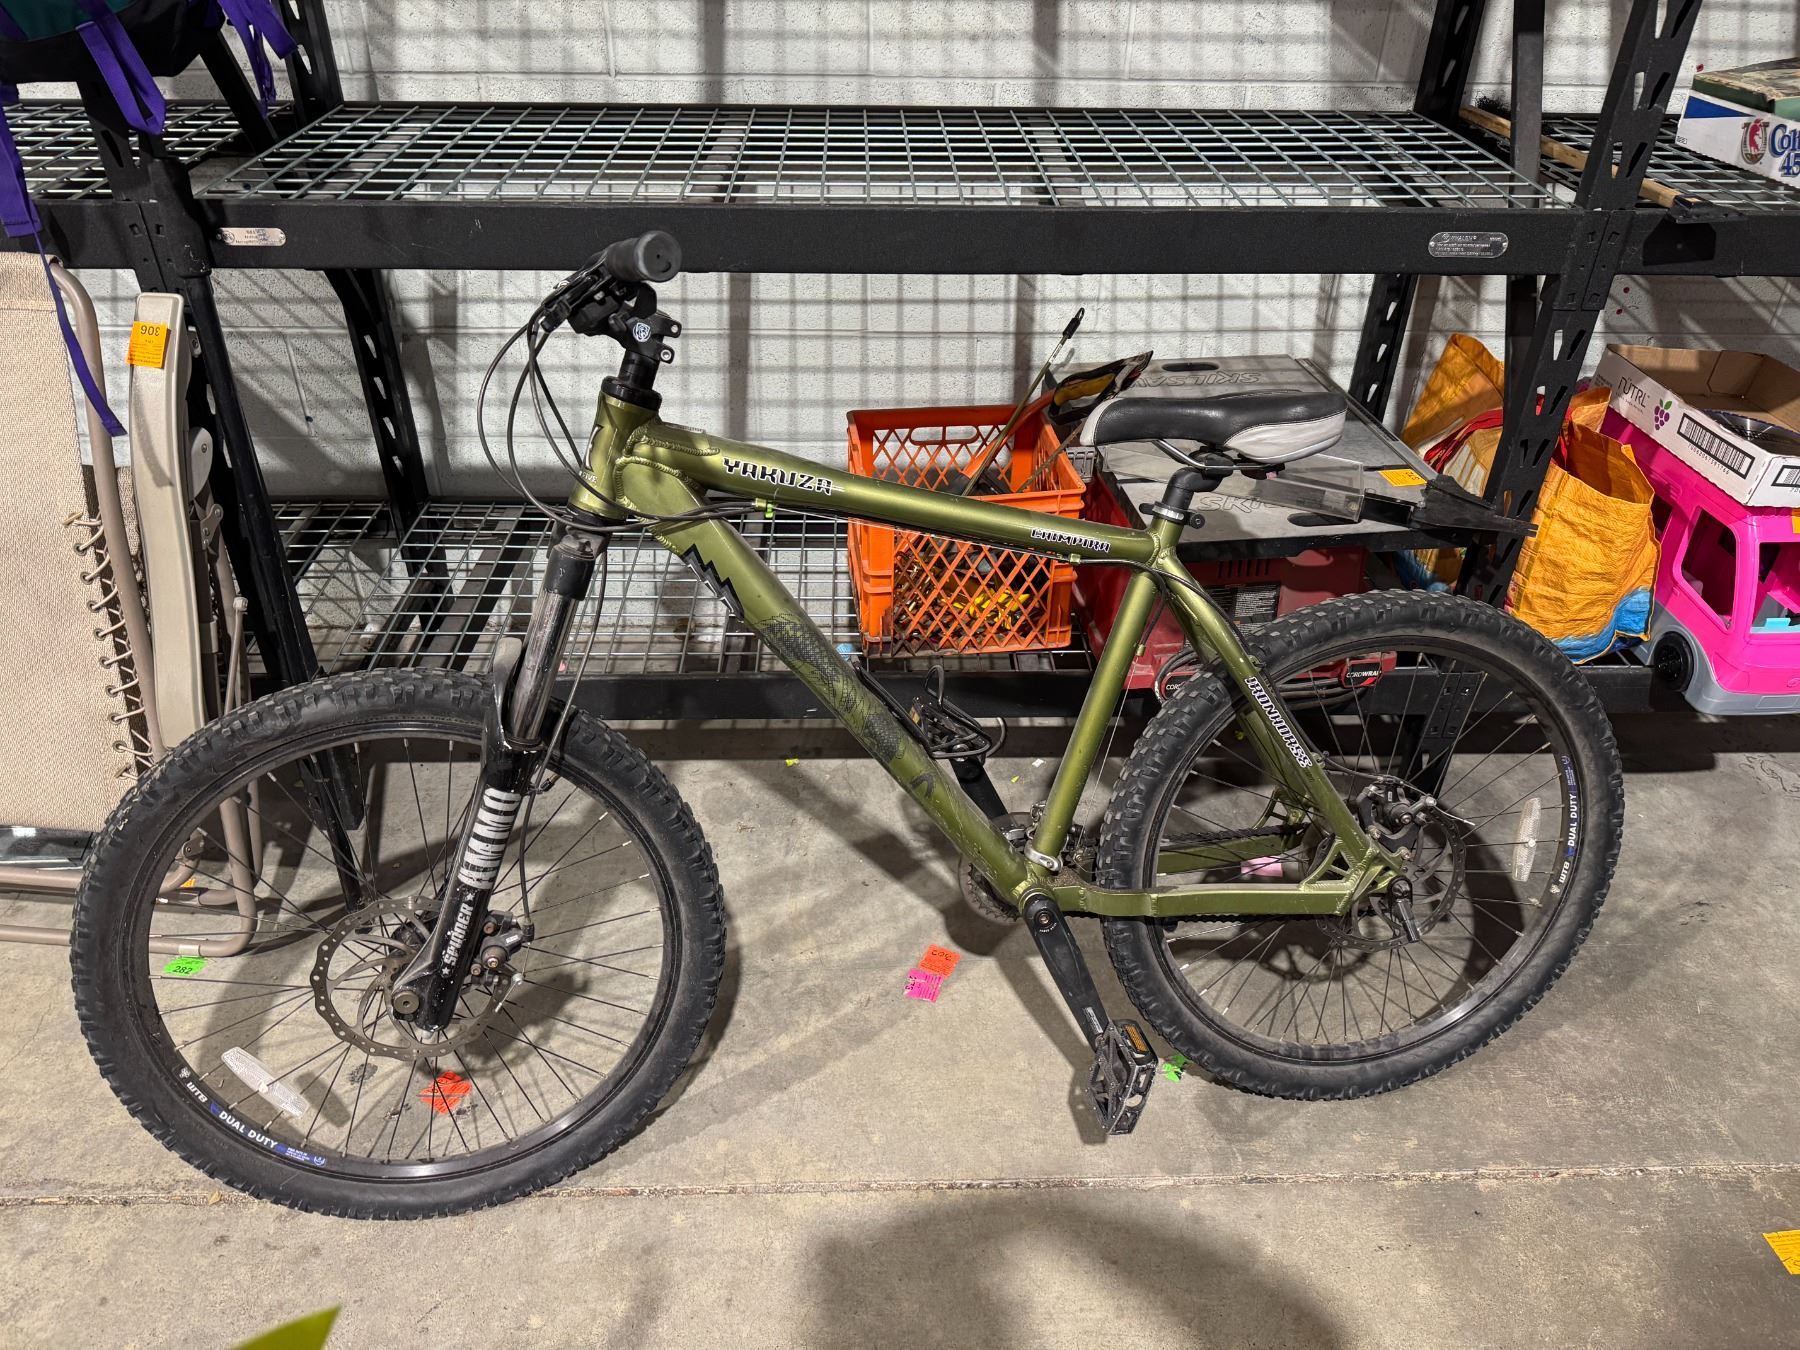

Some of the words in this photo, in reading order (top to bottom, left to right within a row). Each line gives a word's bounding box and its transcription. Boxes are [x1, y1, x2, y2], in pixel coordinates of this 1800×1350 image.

[1770, 124, 1800, 157] Col
[140, 325, 160, 336] 306
[722, 456, 834, 496] YAKUZA
[1031, 527, 1111, 553] CHIMPIRA
[1244, 676, 1312, 768] IRONHORSE
[1569, 793, 1578, 818] DUTY
[457, 787, 522, 890] AMMO
[1567, 821, 1578, 847] DUAL
[1558, 861, 1570, 884] WTB
[172, 965, 193, 975] 282
[186, 1081, 209, 1103] WTB
[218, 1110, 245, 1133] DUAL
[247, 1129, 278, 1149] DUTY
